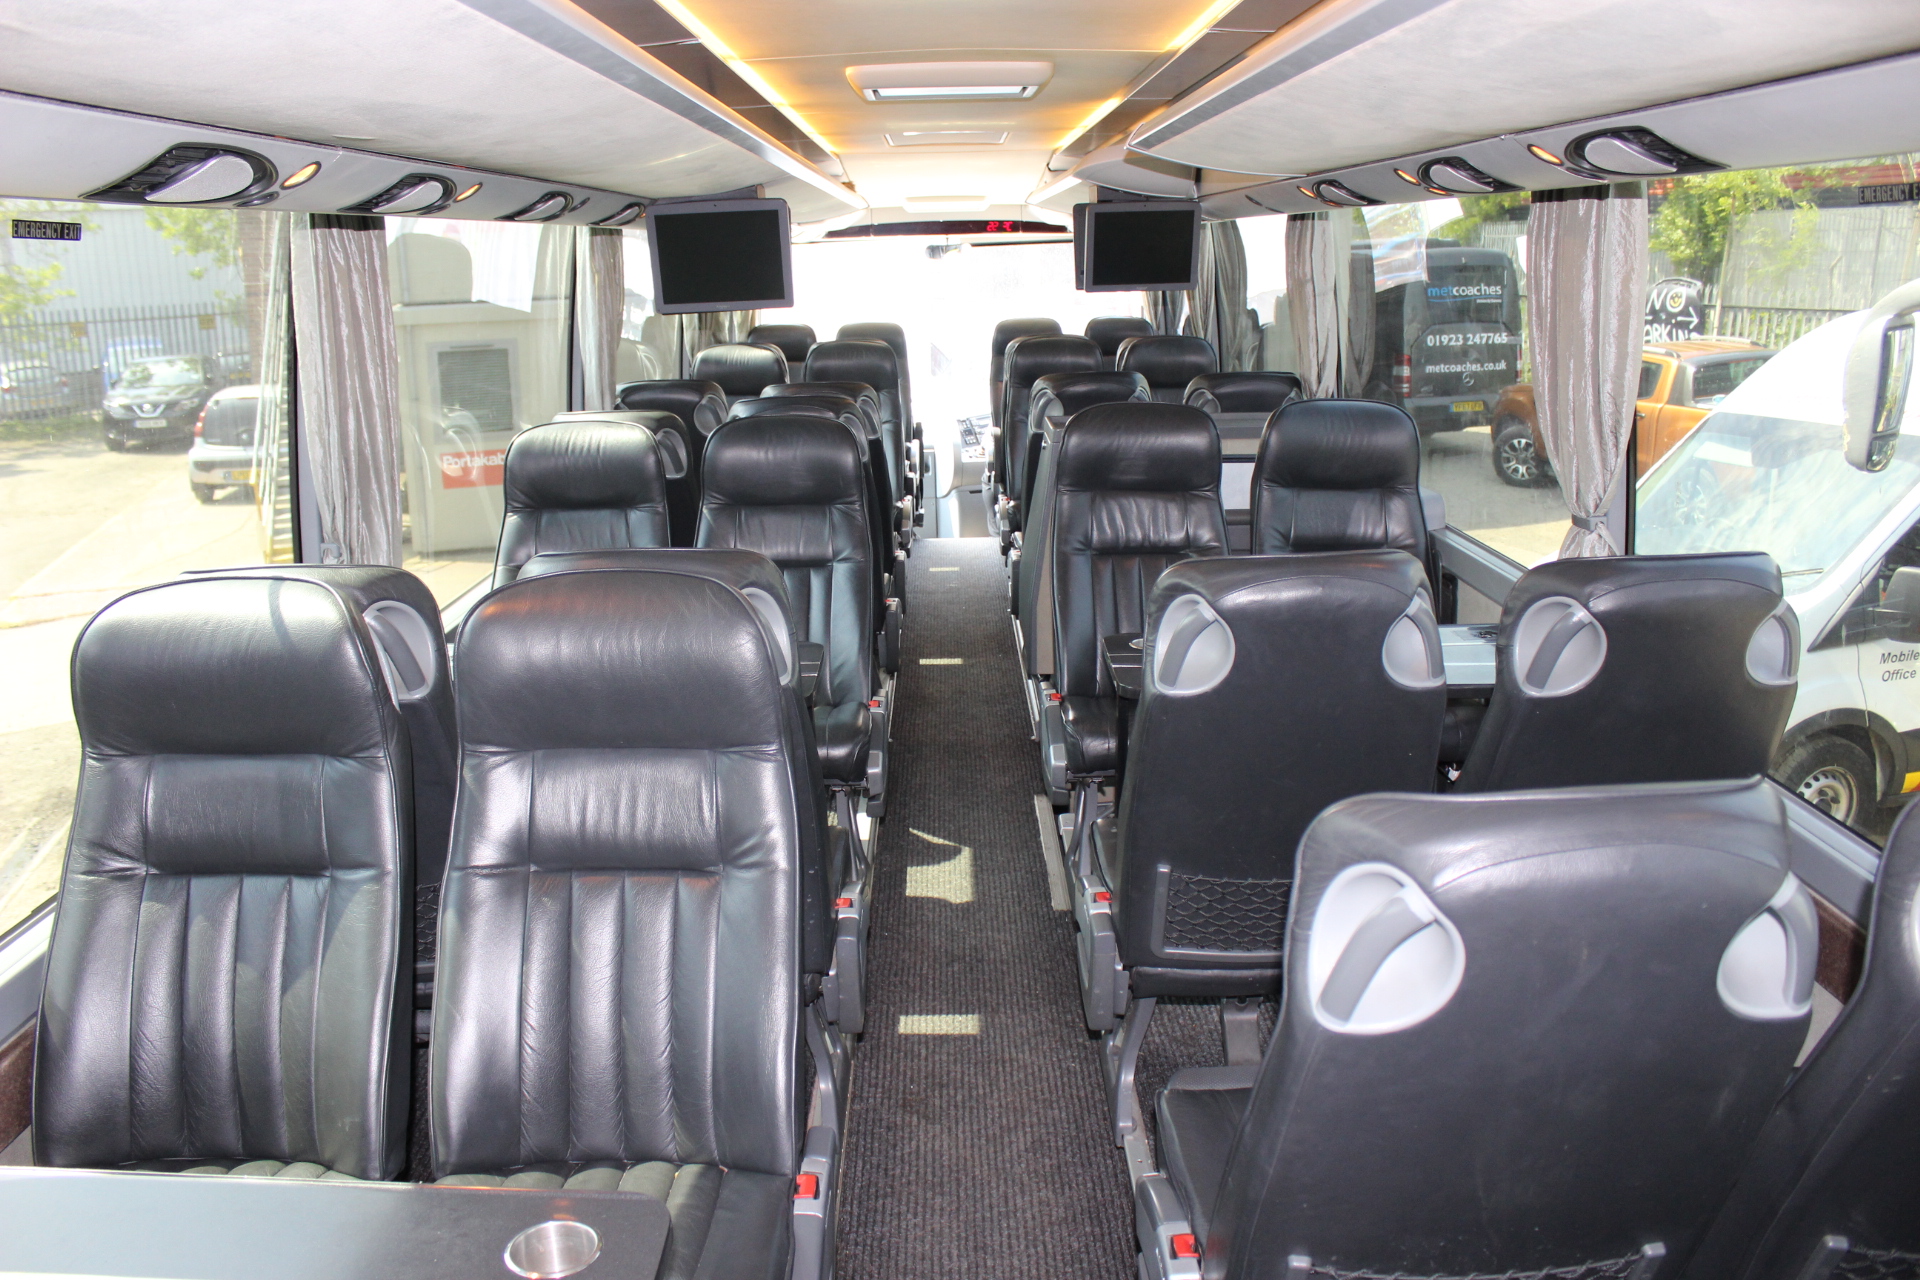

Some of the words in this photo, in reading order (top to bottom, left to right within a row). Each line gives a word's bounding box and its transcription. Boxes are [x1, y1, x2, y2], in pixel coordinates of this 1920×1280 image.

[1859, 184, 1910, 203] EMERGENCY
[13, 220, 62, 238] EMERGENCY
[64, 223, 81, 239] EXIT
[1427, 283, 1502, 296] metcoaches
[1646, 287, 1687, 313] NO
[1427, 333, 1464, 347] 01923
[1466, 332, 1508, 345] 247765
[1643, 323, 1692, 344] ARKIN
[1425, 360, 1507, 374] metcoaches.co.uk
[442, 452, 506, 469] Portakab
[1879, 649, 1920, 665] Mobile
[1881, 668, 1917, 682] Office
